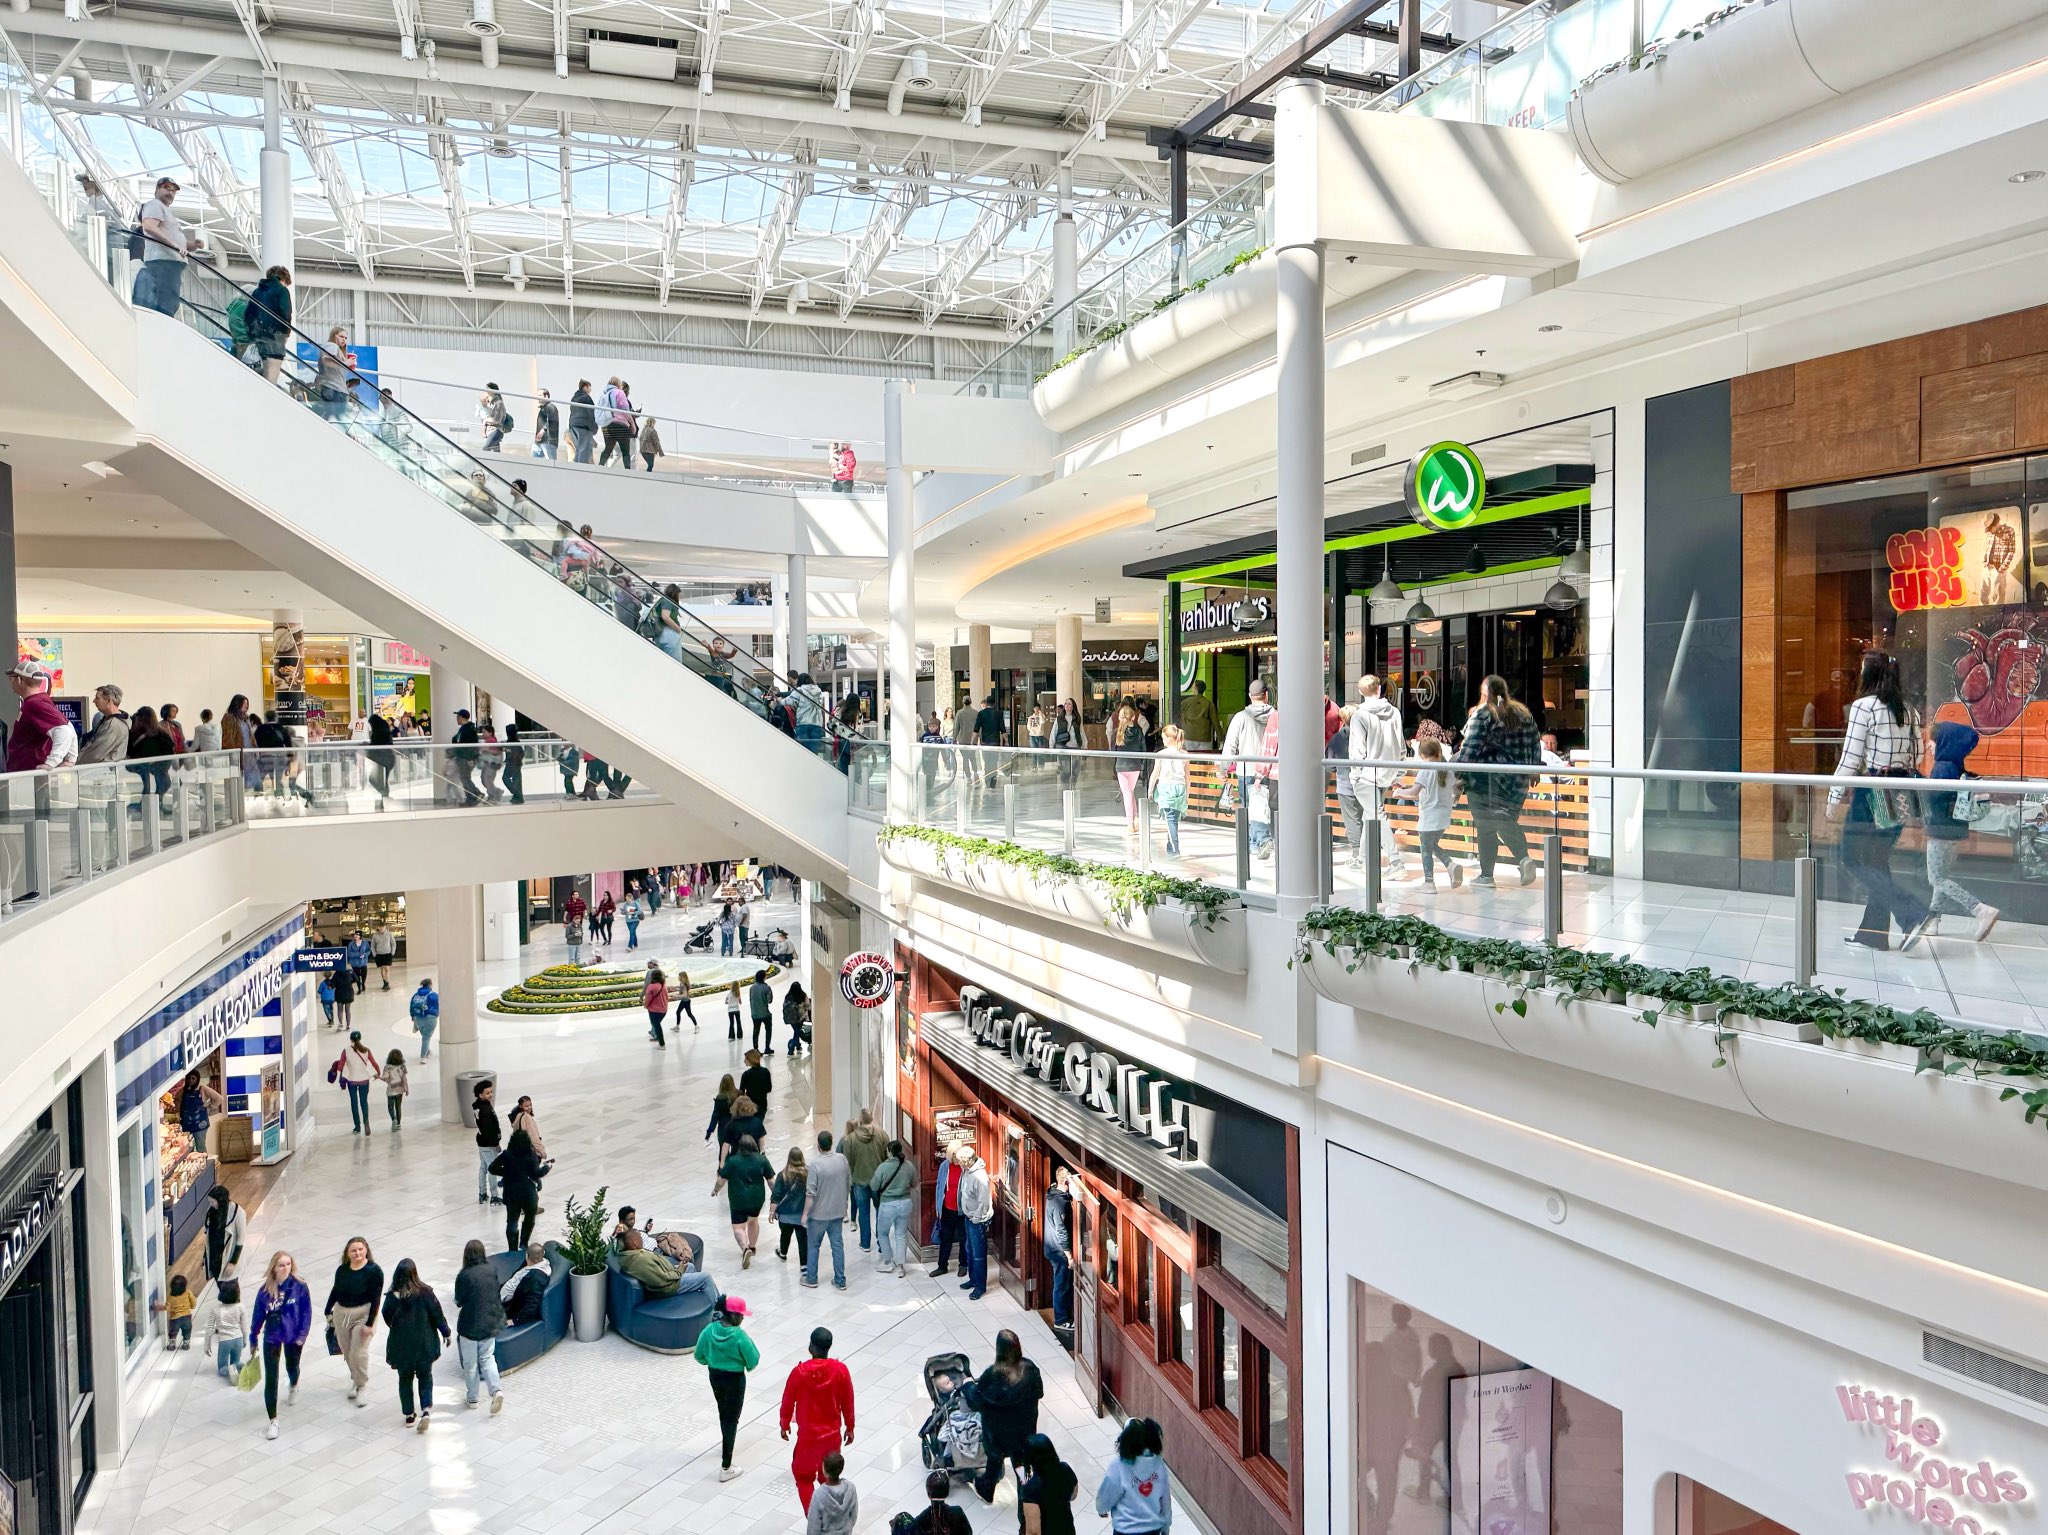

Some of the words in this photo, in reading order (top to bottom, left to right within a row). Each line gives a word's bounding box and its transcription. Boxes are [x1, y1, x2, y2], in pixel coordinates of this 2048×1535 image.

[1181, 597, 1268, 632] ahlburgs
[1082, 649, 1140, 661] Caribou
[298, 953, 317, 961] Bath
[323, 952, 343, 960] Body
[842, 953, 868, 975] TWIN
[871, 953, 893, 974] CITY
[183, 1014, 215, 1070] Bath
[215, 1003, 226, 1039] &
[224, 984, 253, 1036] Body
[251, 964, 282, 1010] Works
[854, 995, 884, 1009] GRILL
[959, 985, 1013, 1048] Twin
[1011, 1012, 1066, 1082] City
[1063, 1041, 1188, 1149] GRILL
[1835, 1385, 1941, 1447] little
[1885, 1431, 2028, 1503] words
[1845, 1472, 2003, 1535] projec
